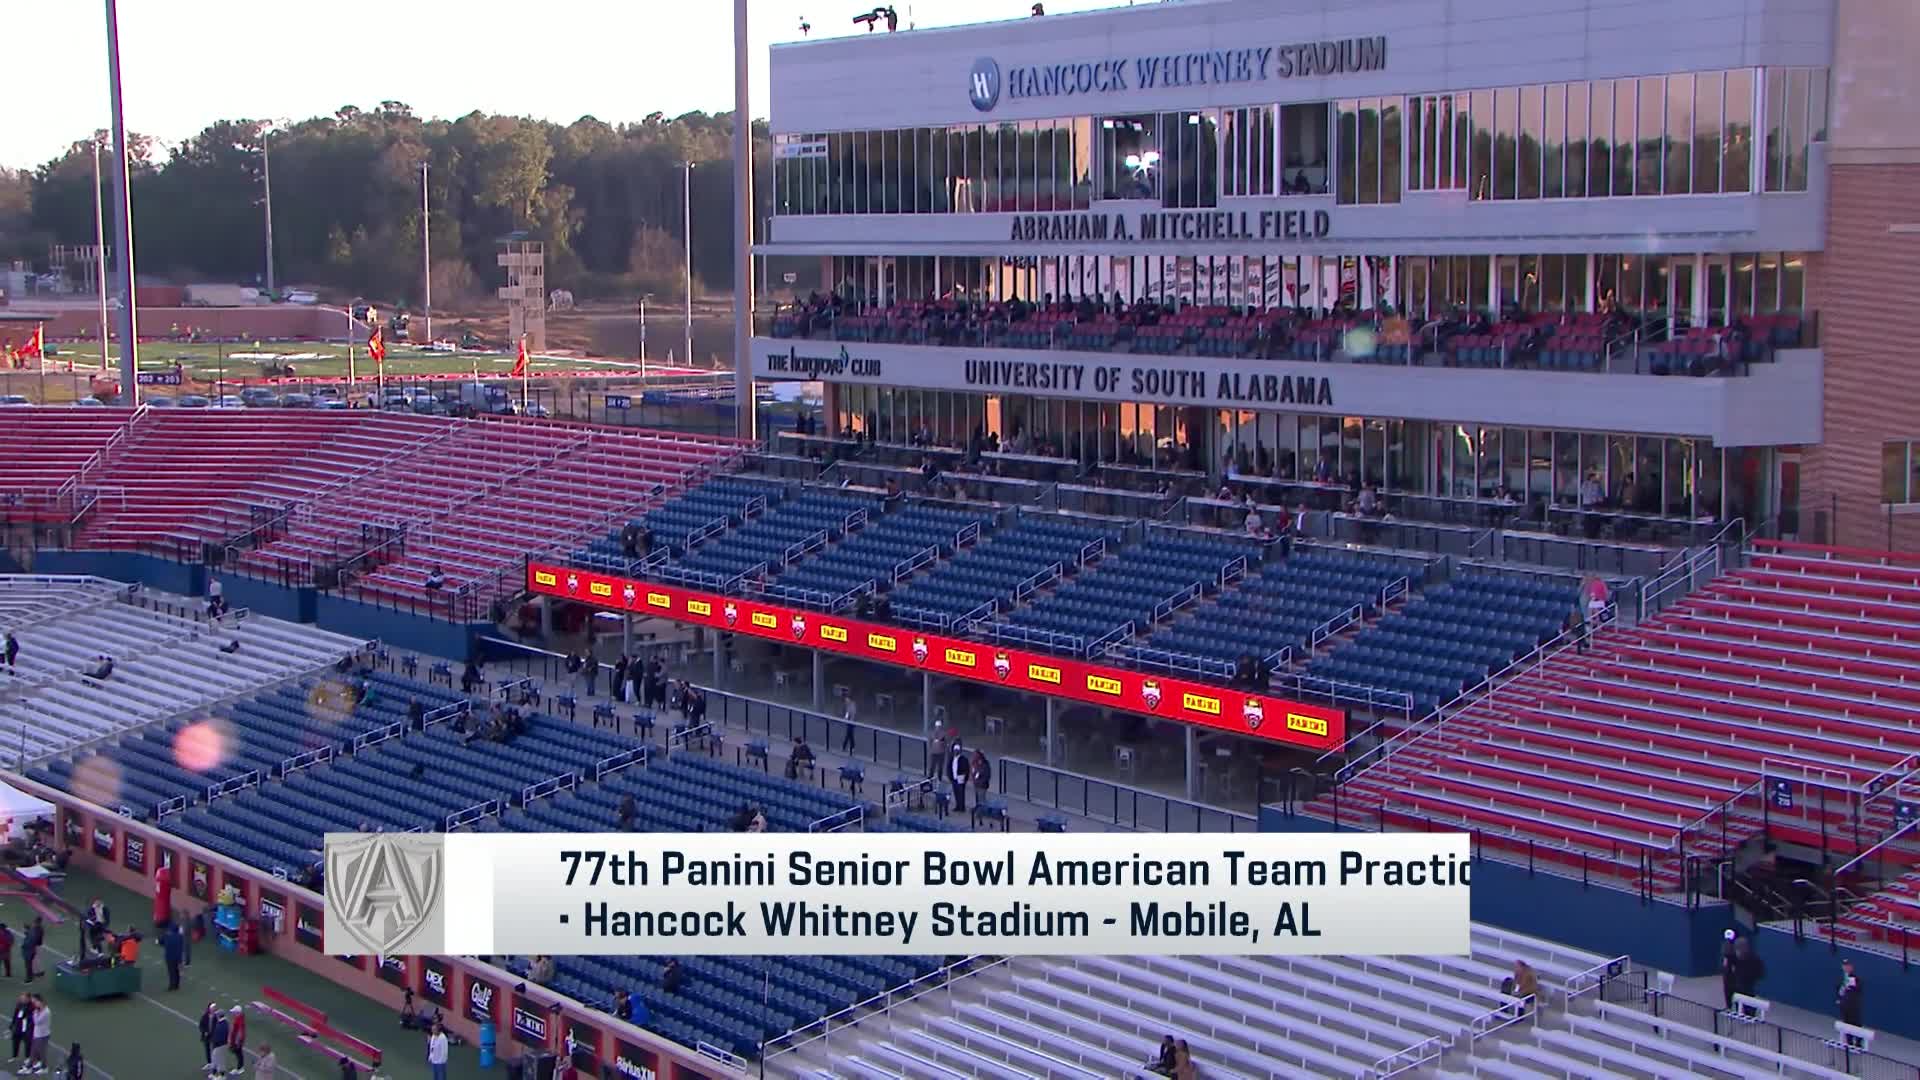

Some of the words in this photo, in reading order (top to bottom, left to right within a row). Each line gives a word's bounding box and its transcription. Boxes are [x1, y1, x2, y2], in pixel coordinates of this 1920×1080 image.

[1010, 58, 1128, 98] HANCOCK
[1137, 47, 1272, 89] WHITNEY
[1277, 36, 1386, 78] STADIUM
[1011, 214, 1108, 241] ABRAHAM
[1113, 213, 1134, 241] A.
[1141, 211, 1253, 240] MITCHELL
[1259, 209, 1330, 239] FIELD
[767, 354, 789, 372] THE
[850, 358, 881, 377] CLUB
[965, 359, 1085, 392] UNIVERSITY
[1094, 365, 1121, 393] OF
[1131, 367, 1206, 398] SOUTH
[1217, 372, 1333, 406] ALABAMA
[1089, 678, 1120, 693] PANINI
[1185, 696, 1218, 712] PANINI
[1289, 716, 1325, 733] PANINI
[426, 968, 445, 986] DEX
[471, 982, 493, 1007] Gulf
[515, 1012, 545, 1035] PANINI
